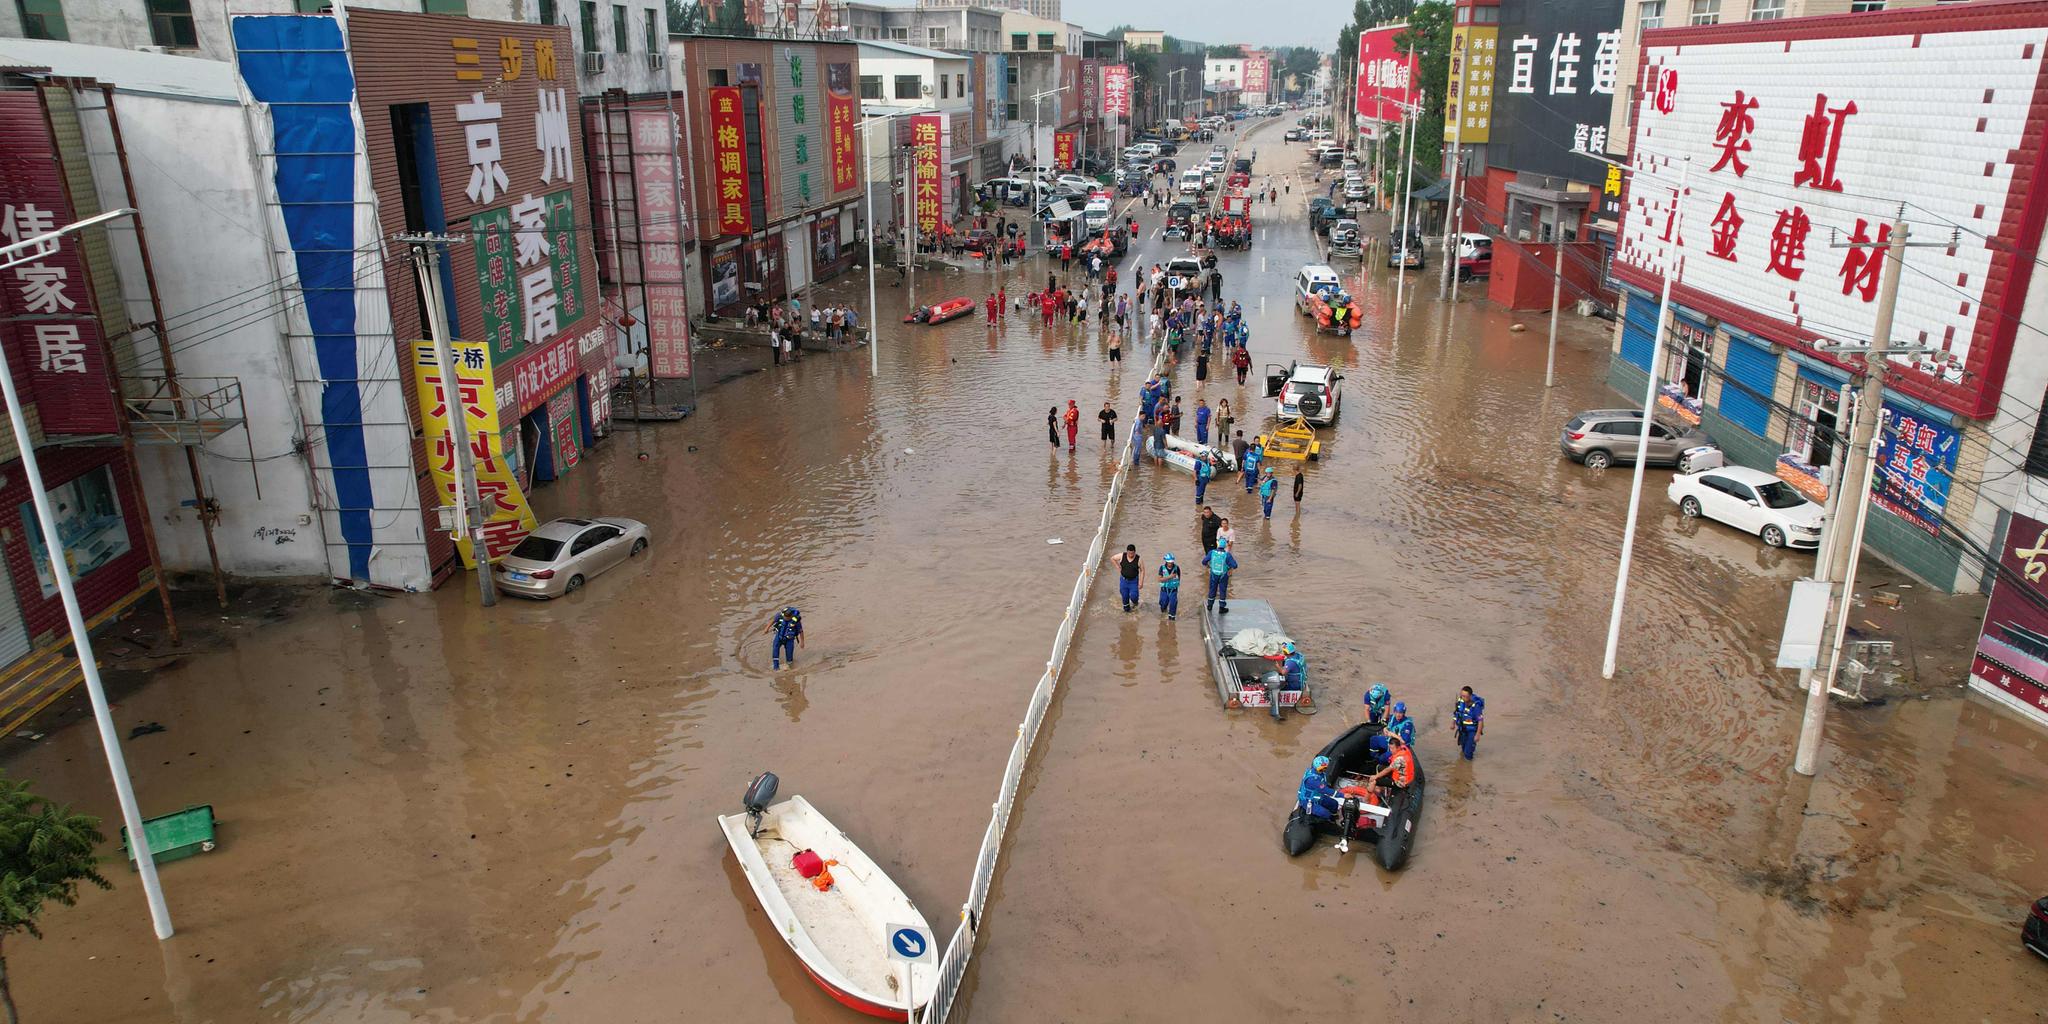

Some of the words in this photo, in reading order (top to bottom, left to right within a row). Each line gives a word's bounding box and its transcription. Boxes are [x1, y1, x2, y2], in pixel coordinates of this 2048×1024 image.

[451, 37, 556, 81] 三步桥
[455, 88, 574, 205] 京州
[832, 105, 845, 184] 全屋定制
[1574, 123, 1606, 155] 瓷砖
[1709, 89, 1858, 193] 奕虹
[485, 223, 514, 354] 品牌老店
[511, 193, 558, 345] 家居
[553, 203, 577, 317] 厂家直销
[517, 338, 575, 402] 内设大型展厅
[652, 298, 671, 374] 所有商品
[669, 298, 689, 375] 低价甩卖
[1890, 444, 1931, 483] 五金
[1897, 416, 1938, 455] 奕虹
